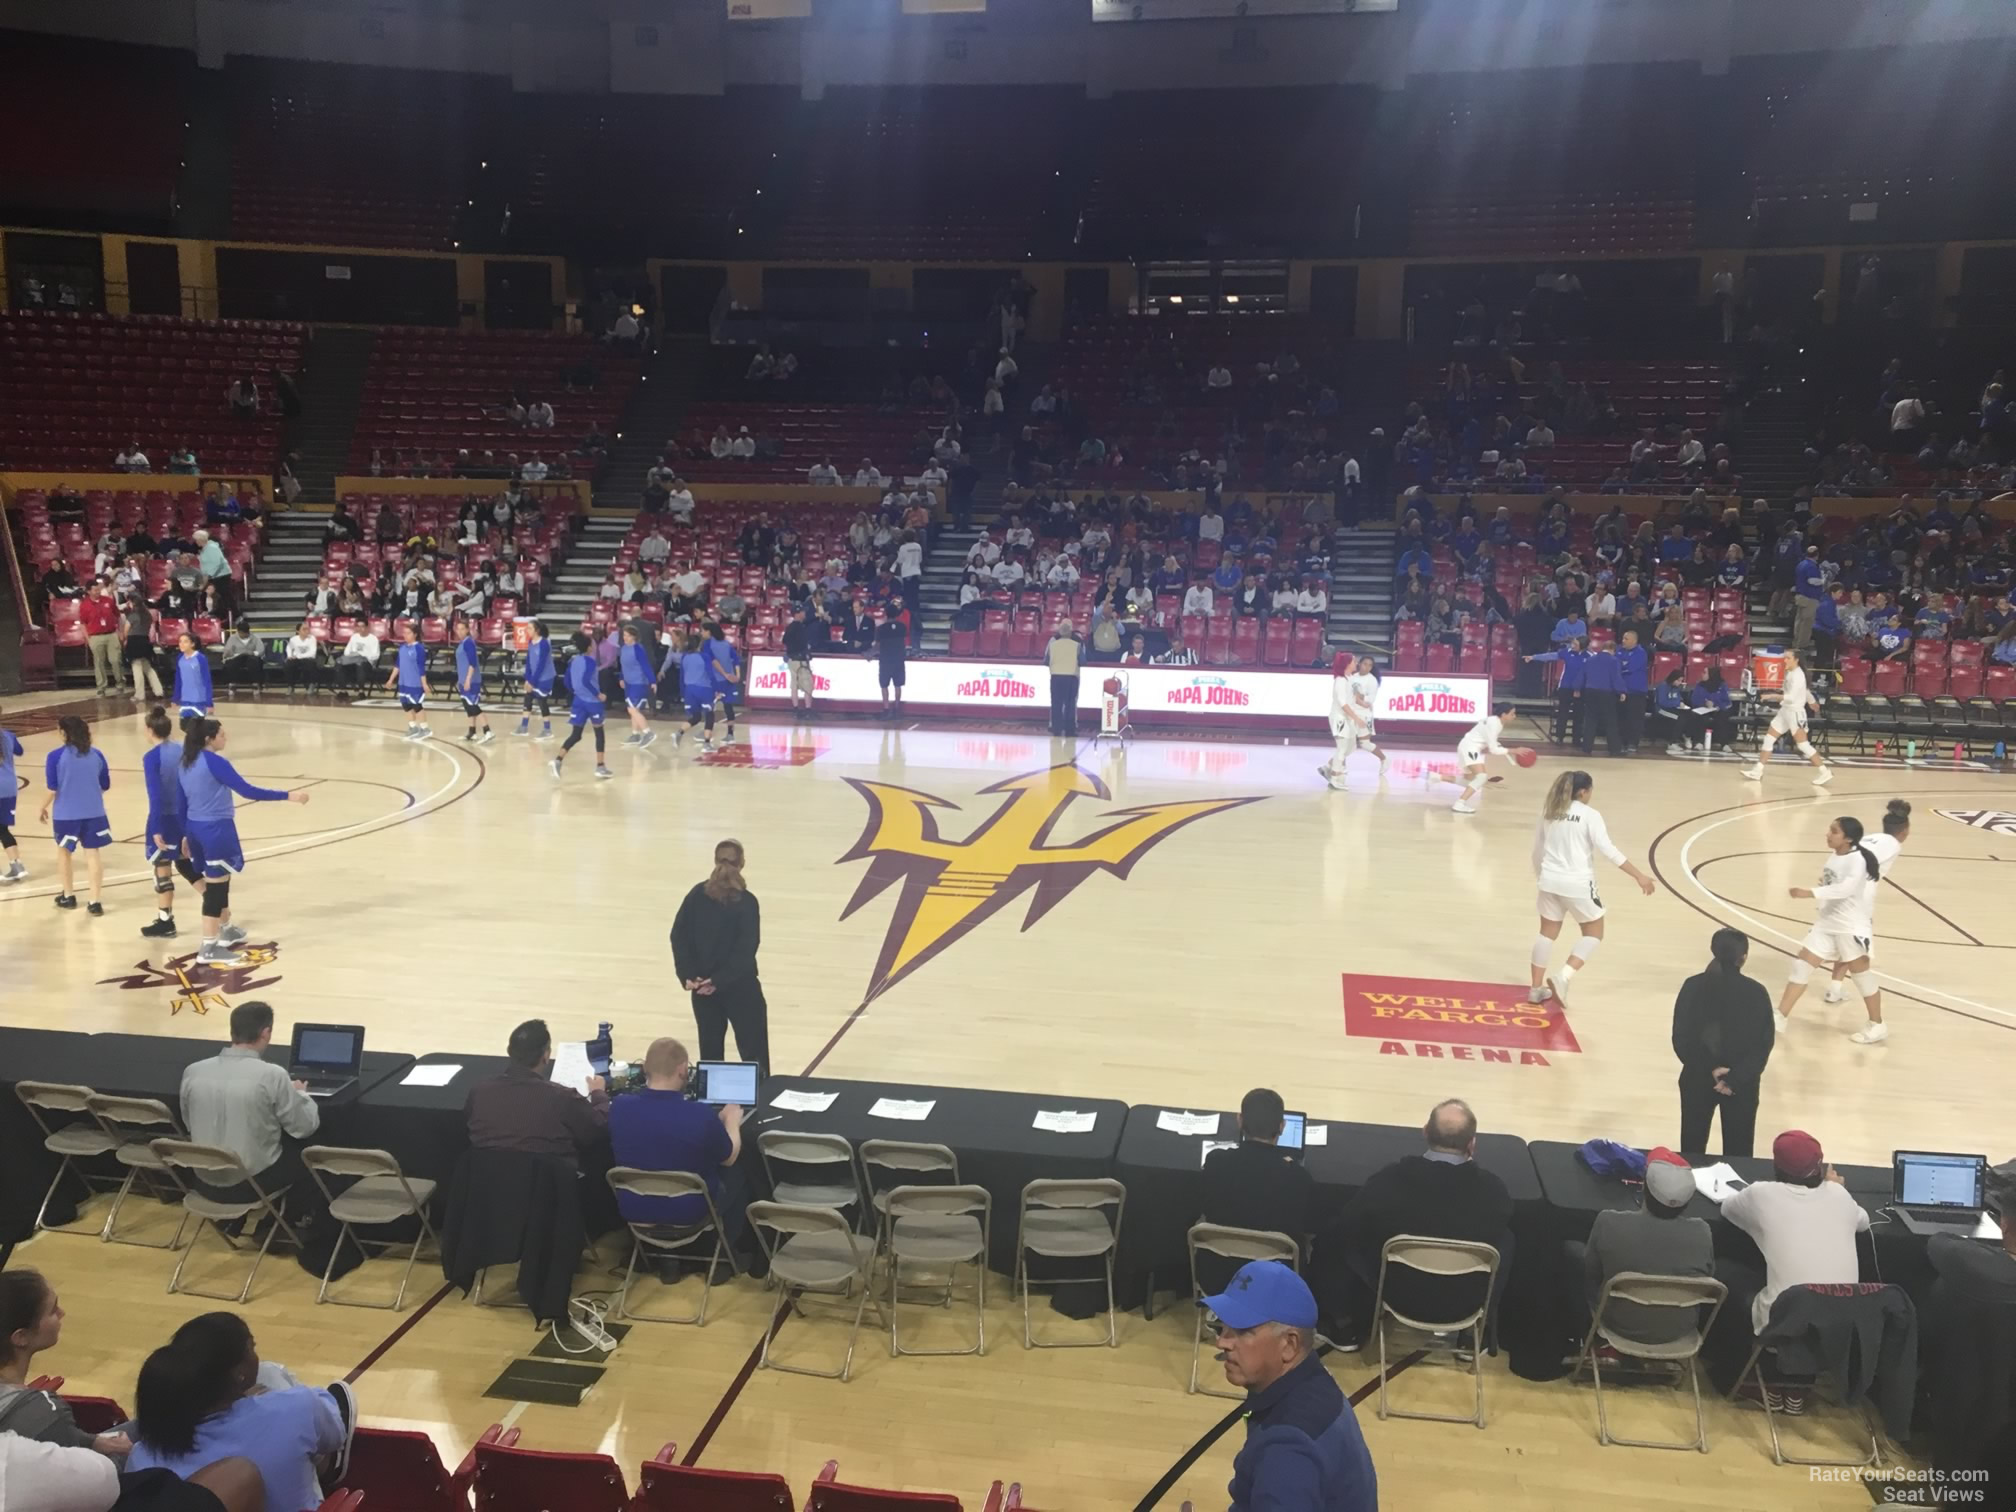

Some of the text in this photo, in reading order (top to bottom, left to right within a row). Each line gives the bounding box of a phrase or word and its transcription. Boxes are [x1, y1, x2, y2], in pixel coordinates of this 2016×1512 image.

[1768, 663, 1778, 673] G
[755, 671, 787, 689] PAPA
[957, 679, 1035, 699] PAPA JOHNS
[1167, 686, 1249, 706] PAPA JOHNS
[1389, 693, 1476, 714] PAPA JOHNS
[1359, 992, 1548, 1014] WELLS
[1371, 1006, 1551, 1028] FARGO
[1379, 1041, 1551, 1066] ARENA
